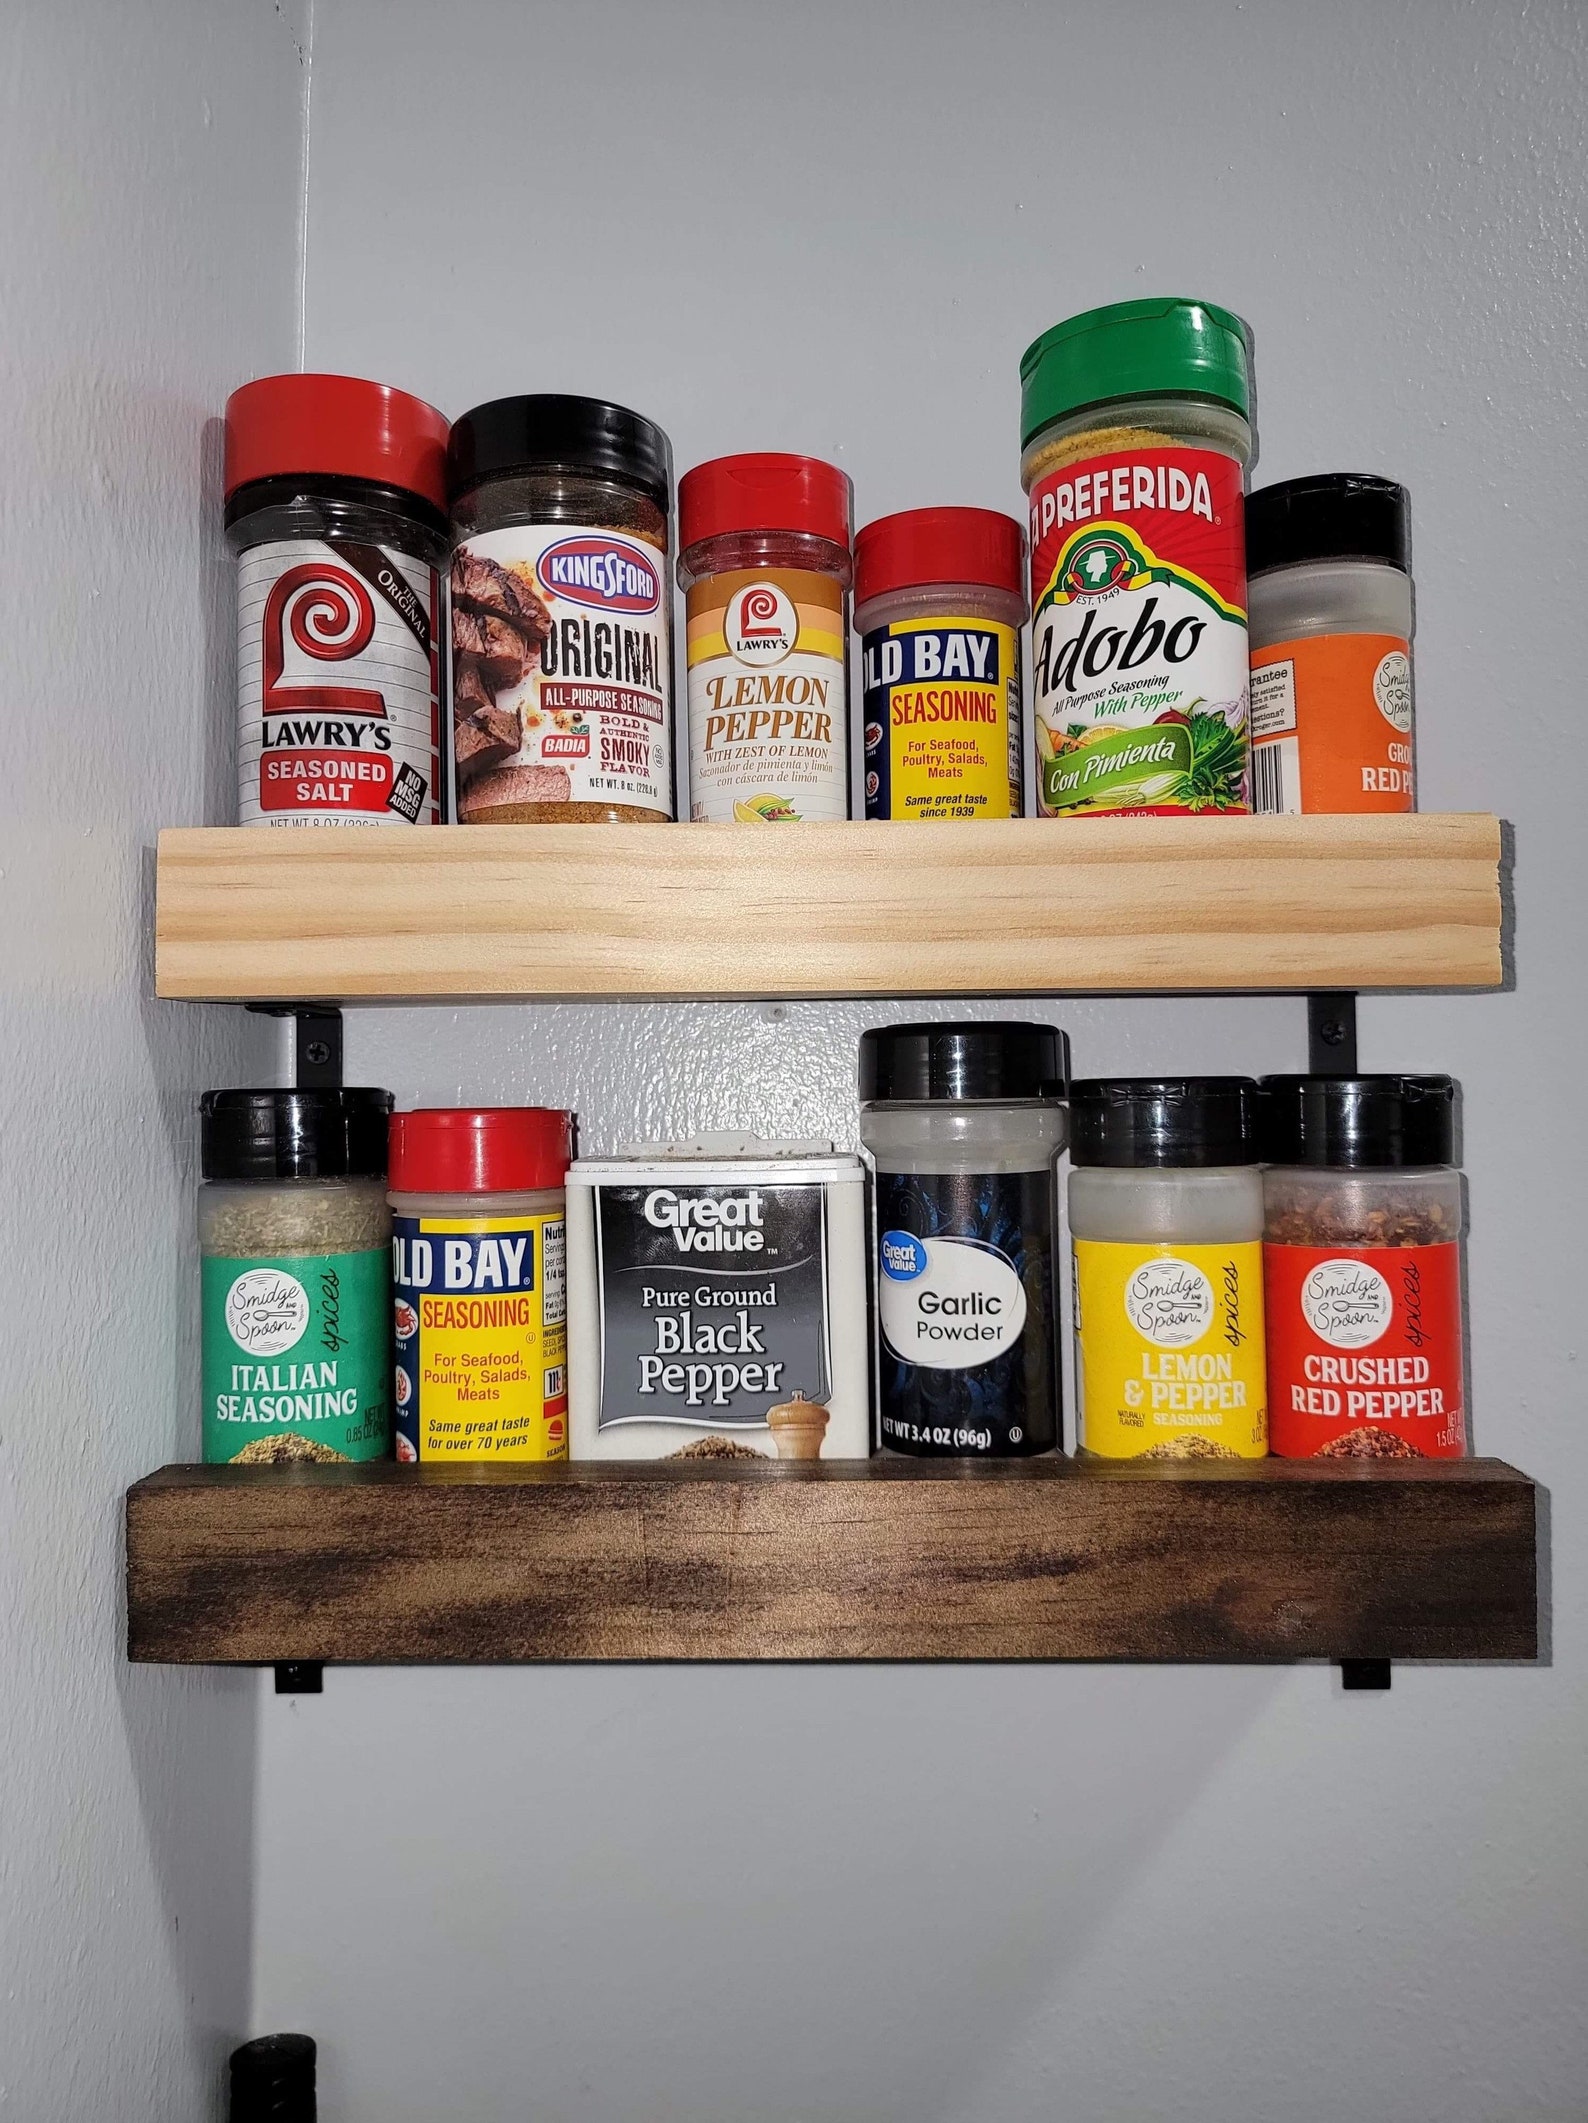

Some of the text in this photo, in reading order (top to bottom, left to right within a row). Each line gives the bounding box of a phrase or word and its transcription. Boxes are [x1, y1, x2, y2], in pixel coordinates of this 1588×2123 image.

[1032, 466, 1213, 553] A PREFERIDA
[552, 551, 654, 599] KINGSFORD
[378, 570, 426, 638] ORIGINAL
[404, 586, 418, 608] THE
[1076, 588, 1120, 606] EST. 1949
[541, 619, 663, 694] ORIGINAL
[737, 638, 788, 652] LAWRY'S
[915, 634, 991, 680] BAY
[1034, 598, 1208, 699] Adobo
[1250, 670, 1288, 687] rantee
[546, 688, 662, 720] ALL-PURPOSE SEASONING
[707, 676, 830, 711] LEMON
[1052, 674, 1170, 717] All Purpose Seasoning
[1094, 690, 1184, 719] With Pepper
[892, 690, 997, 726] SEASONING
[1253, 708, 1285, 723] estions?
[262, 720, 392, 750] LAWRY'S
[600, 715, 650, 732] BOLD &
[600, 728, 650, 742] AUTHENTIC
[704, 710, 832, 752] PEPPER
[545, 739, 586, 753] BADIA
[601, 737, 650, 767] SMOKY
[706, 749, 732, 764] WITH
[735, 746, 766, 759] ZEST
[769, 746, 786, 757] OF
[790, 746, 829, 760] LEMON
[909, 739, 979, 752] For Seafood,
[1388, 742, 1412, 766] GRO
[268, 760, 386, 782] SEASONED
[600, 762, 650, 778] FLAVOR
[699, 759, 833, 779] Sazonador de pimienta y limón
[903, 753, 988, 768] Poultry, Salads,
[928, 767, 963, 778] Meats
[1050, 737, 1176, 794] Con Pimienta
[405, 770, 422, 791] NO
[590, 778, 604, 788] NET
[607, 779, 620, 790] WT.
[621, 781, 625, 790] 8
[717, 771, 818, 787] con cáscara de limón
[1361, 767, 1400, 792] RED
[296, 782, 354, 802] SALT
[394, 780, 421, 808] MSG
[905, 794, 988, 807] Same great taste
[390, 794, 416, 818] ADDED
[920, 806, 974, 818] since 1939
[644, 1189, 764, 1228] Great
[545, 1227, 565, 1240] Nutri
[672, 1225, 764, 1253] Value
[445, 1238, 527, 1289] BAY
[883, 1241, 917, 1262] Great
[888, 1258, 917, 1273] Value
[232, 1280, 300, 1310] Smidge
[642, 1283, 777, 1308] Pure Ground
[1132, 1271, 1204, 1300] Smidge
[1308, 1271, 1382, 1300] Smidge
[316, 1267, 350, 1352] spices
[424, 1298, 530, 1329] SEASONING
[919, 1291, 1003, 1316] Garlic
[1220, 1261, 1247, 1347] spices
[1399, 1261, 1432, 1348] spices
[236, 1312, 293, 1346] Spoon
[917, 1322, 1004, 1340] Powder
[1137, 1302, 1196, 1336] Spoon
[1314, 1303, 1374, 1336] Spoon
[654, 1310, 765, 1354] Black
[434, 1351, 524, 1367] For Seafood,
[1142, 1353, 1232, 1382] LEMON
[1304, 1355, 1430, 1385] CRUSHED
[231, 1361, 338, 1392] ITALIAN
[425, 1368, 531, 1386] Poultry, Salads,
[638, 1356, 784, 1405] Pepper
[216, 1388, 358, 1424] SEASONING
[457, 1388, 500, 1401] Meats
[1124, 1380, 1247, 1411] & PEPPER
[1291, 1385, 1341, 1417] RED
[1347, 1388, 1444, 1418] PEPPER
[429, 1416, 530, 1435] Same great taste
[1117, 1410, 1146, 1420] NATURALLY
[1153, 1413, 1223, 1426] SEASONING
[428, 1436, 528, 1451] for over 70 years
[894, 1425, 911, 1440] WT
[912, 1428, 930, 1442] 3.4
[934, 1429, 951, 1444] OZ
[954, 1429, 992, 1448] (96g)
